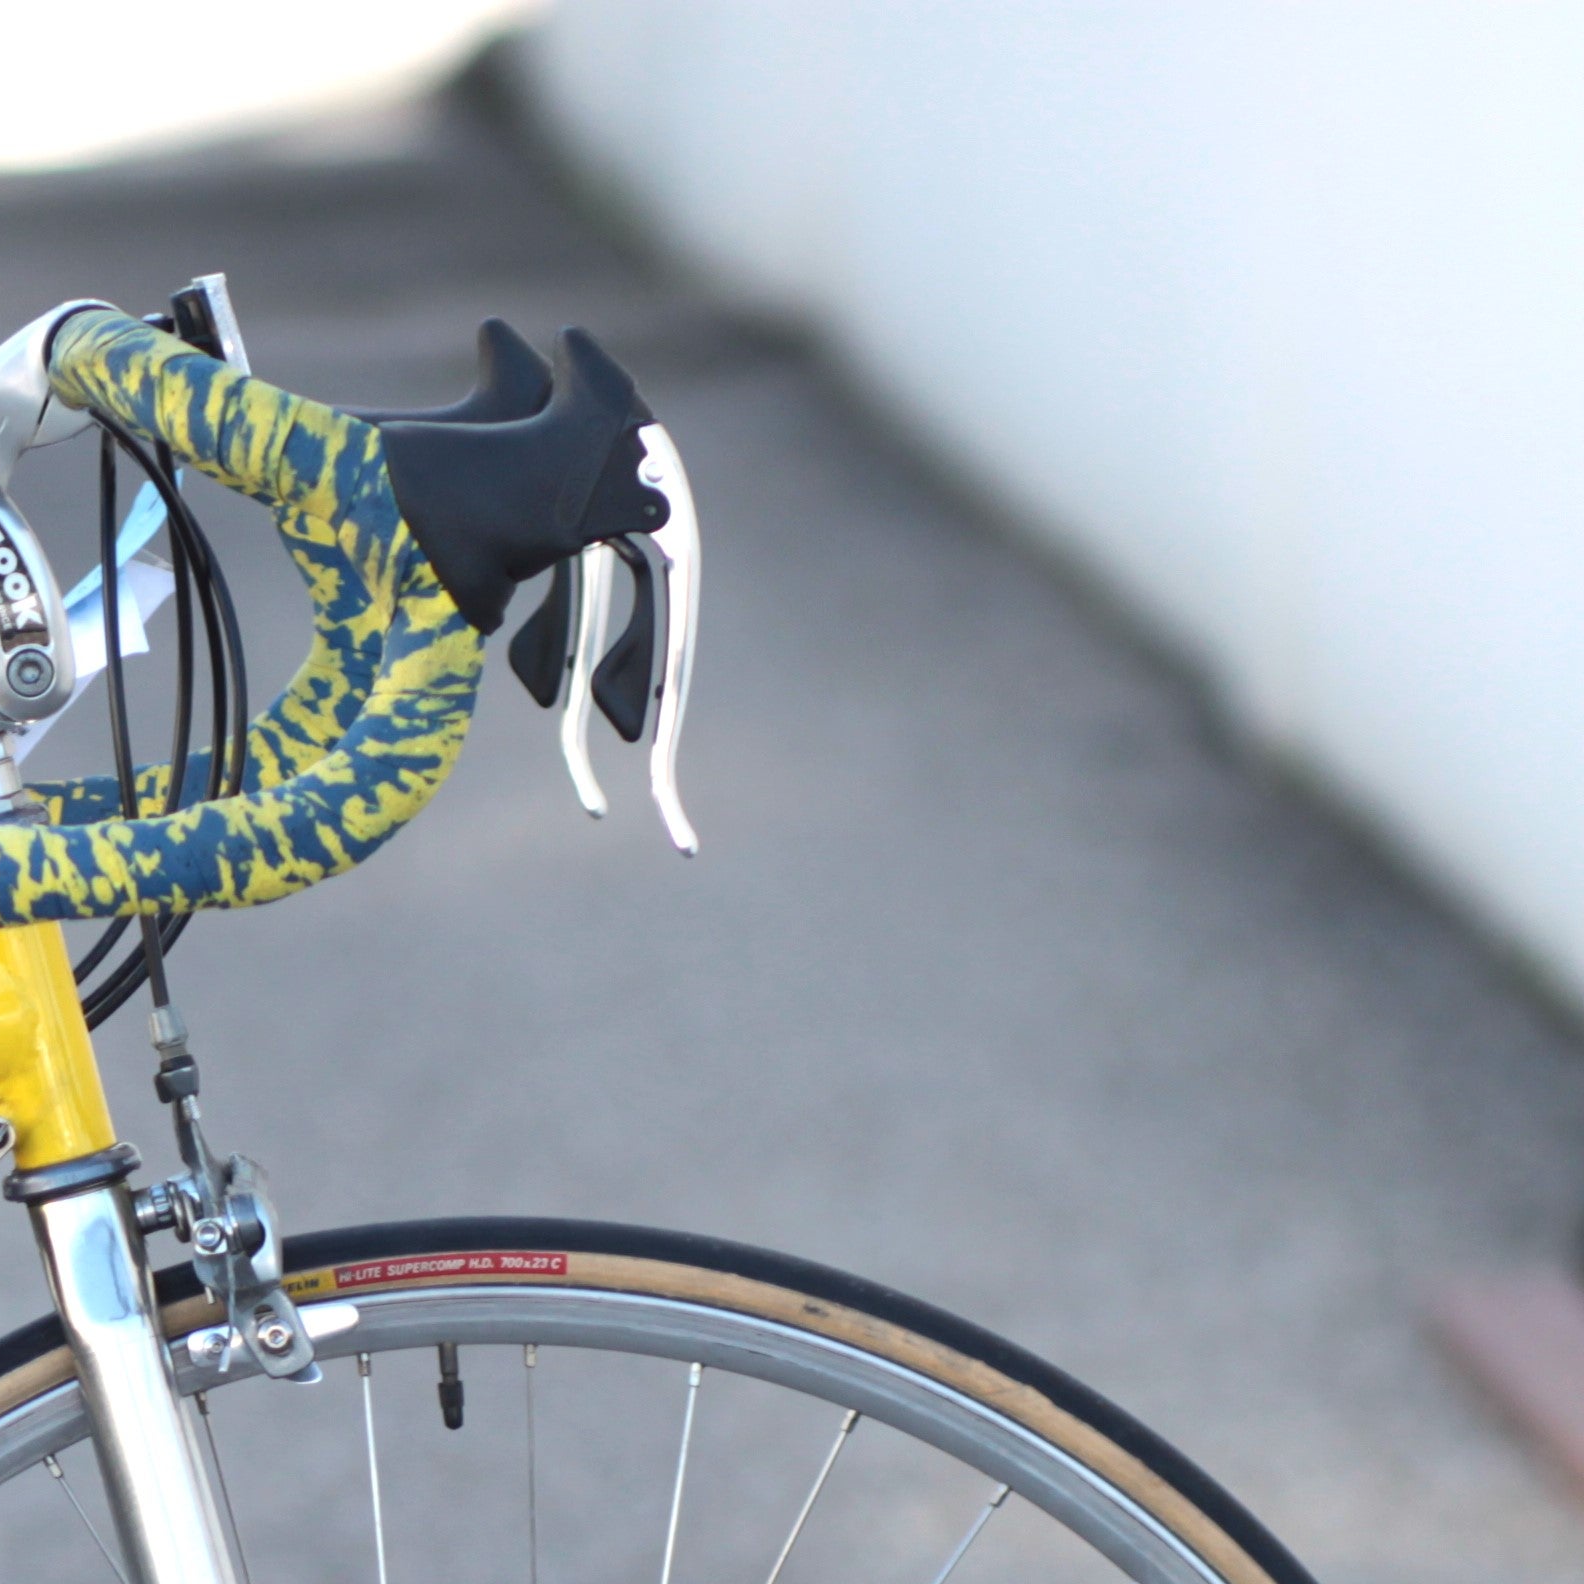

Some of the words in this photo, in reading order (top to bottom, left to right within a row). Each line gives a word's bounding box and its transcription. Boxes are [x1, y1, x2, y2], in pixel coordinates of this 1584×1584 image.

[339, 1266, 382, 1284] HI-LITE
[387, 1258, 466, 1276] SUPERCOMP
[469, 1257, 494, 1269] H.D.
